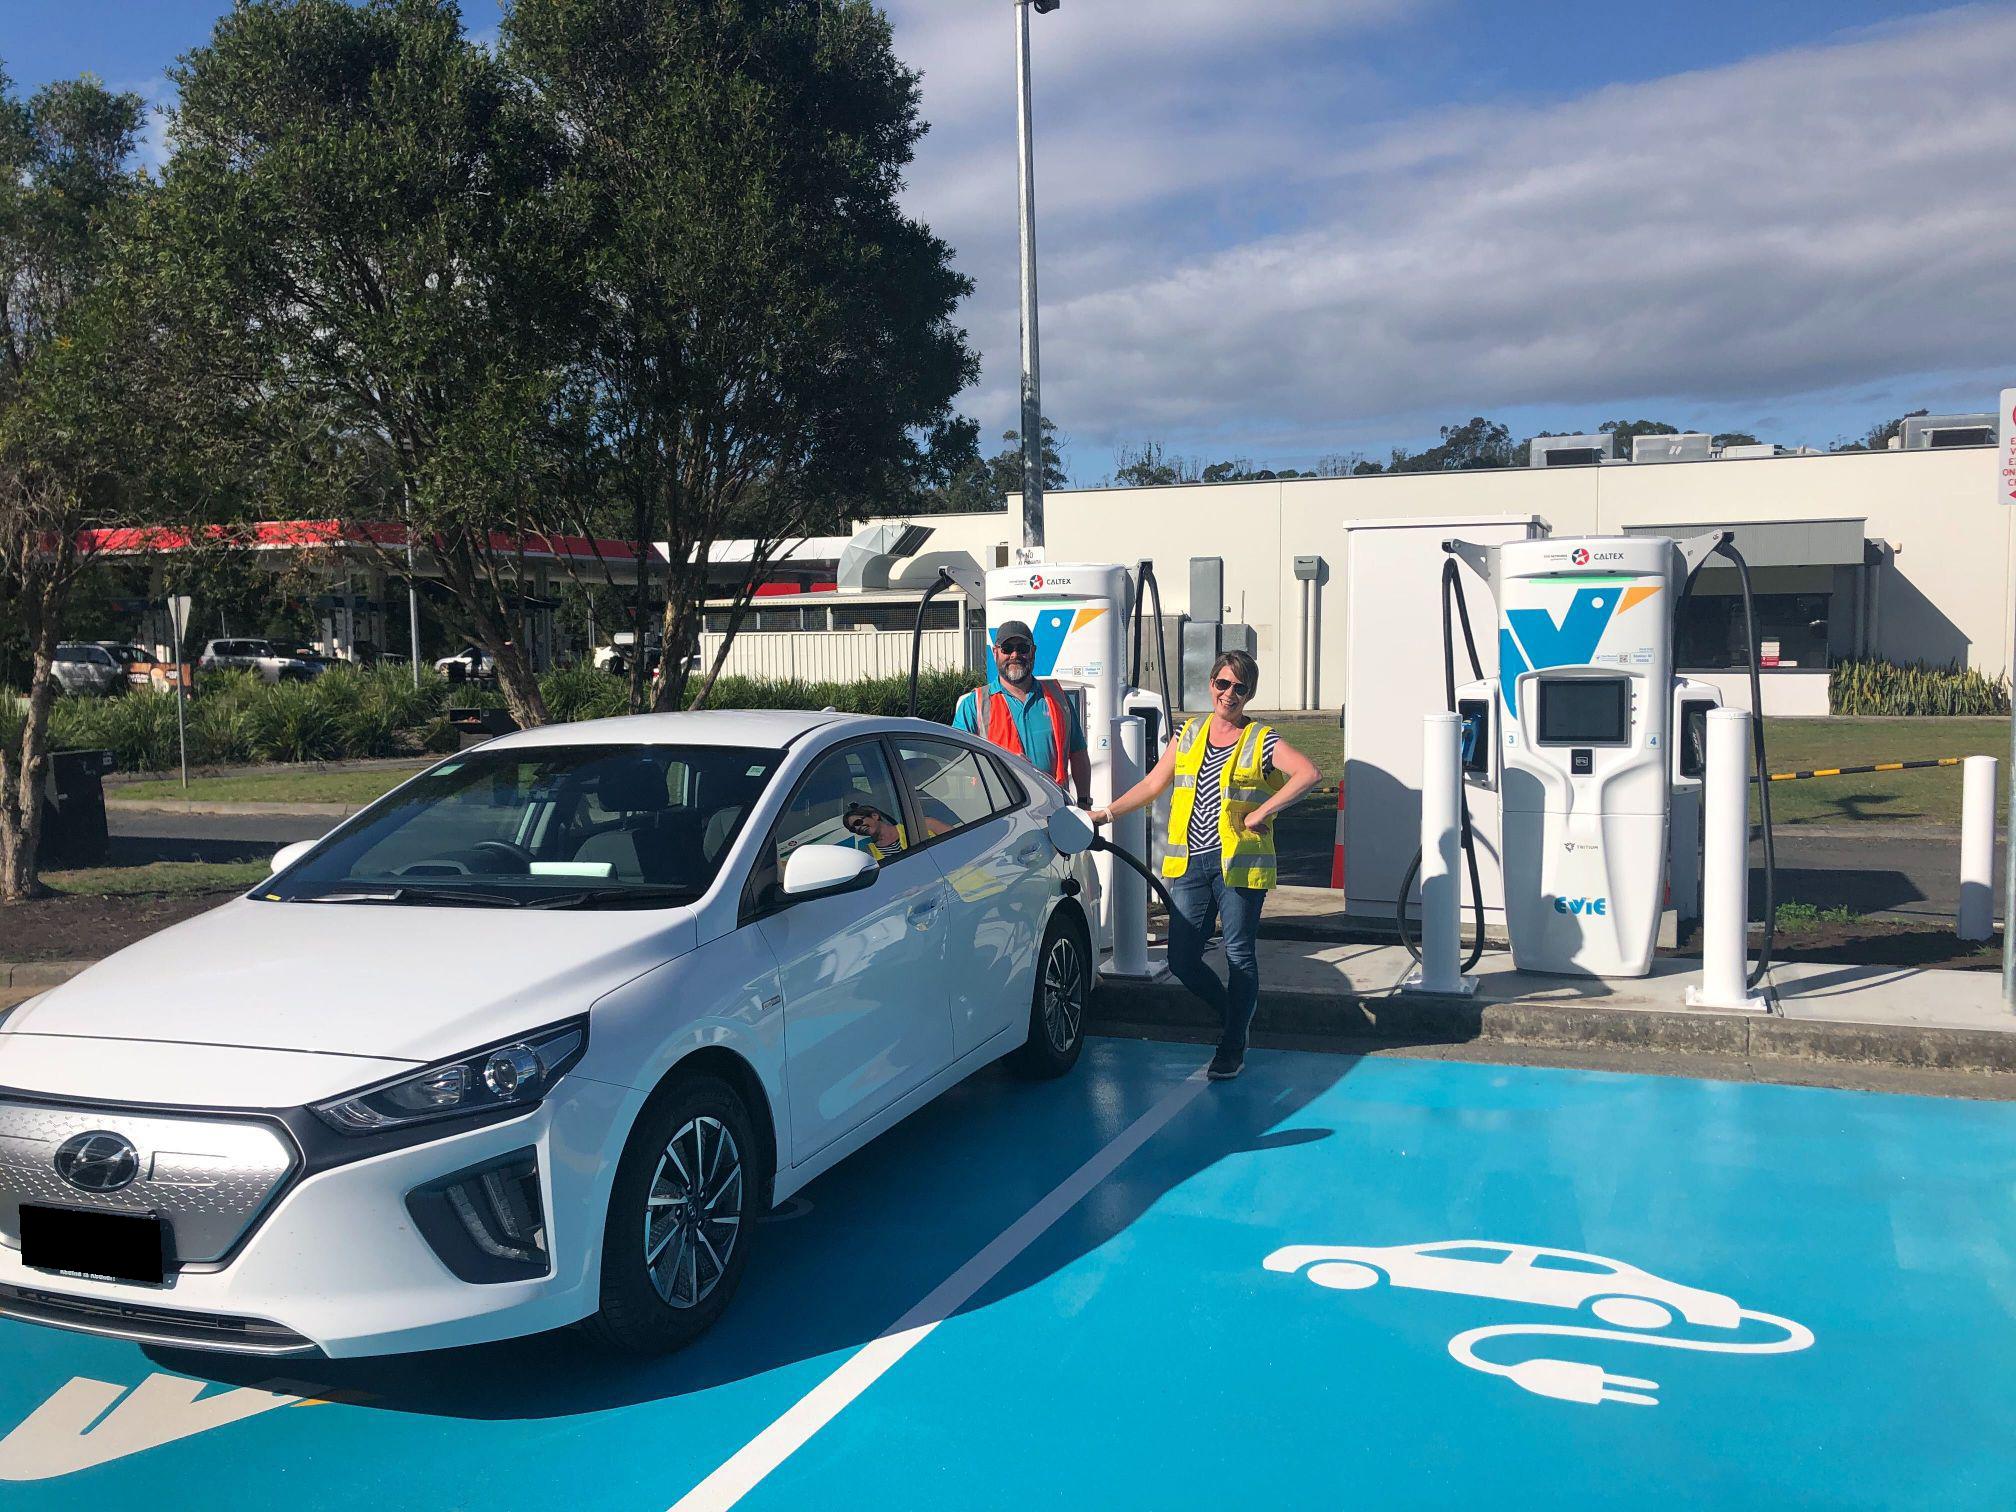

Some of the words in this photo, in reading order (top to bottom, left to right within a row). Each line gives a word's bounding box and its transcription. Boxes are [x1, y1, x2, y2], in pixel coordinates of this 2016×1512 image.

[1593, 552, 1625, 560] CALTEX
[1101, 738, 1108, 747] 2
[1508, 735, 1514, 744] 3
[1650, 736, 1657, 745] 4
